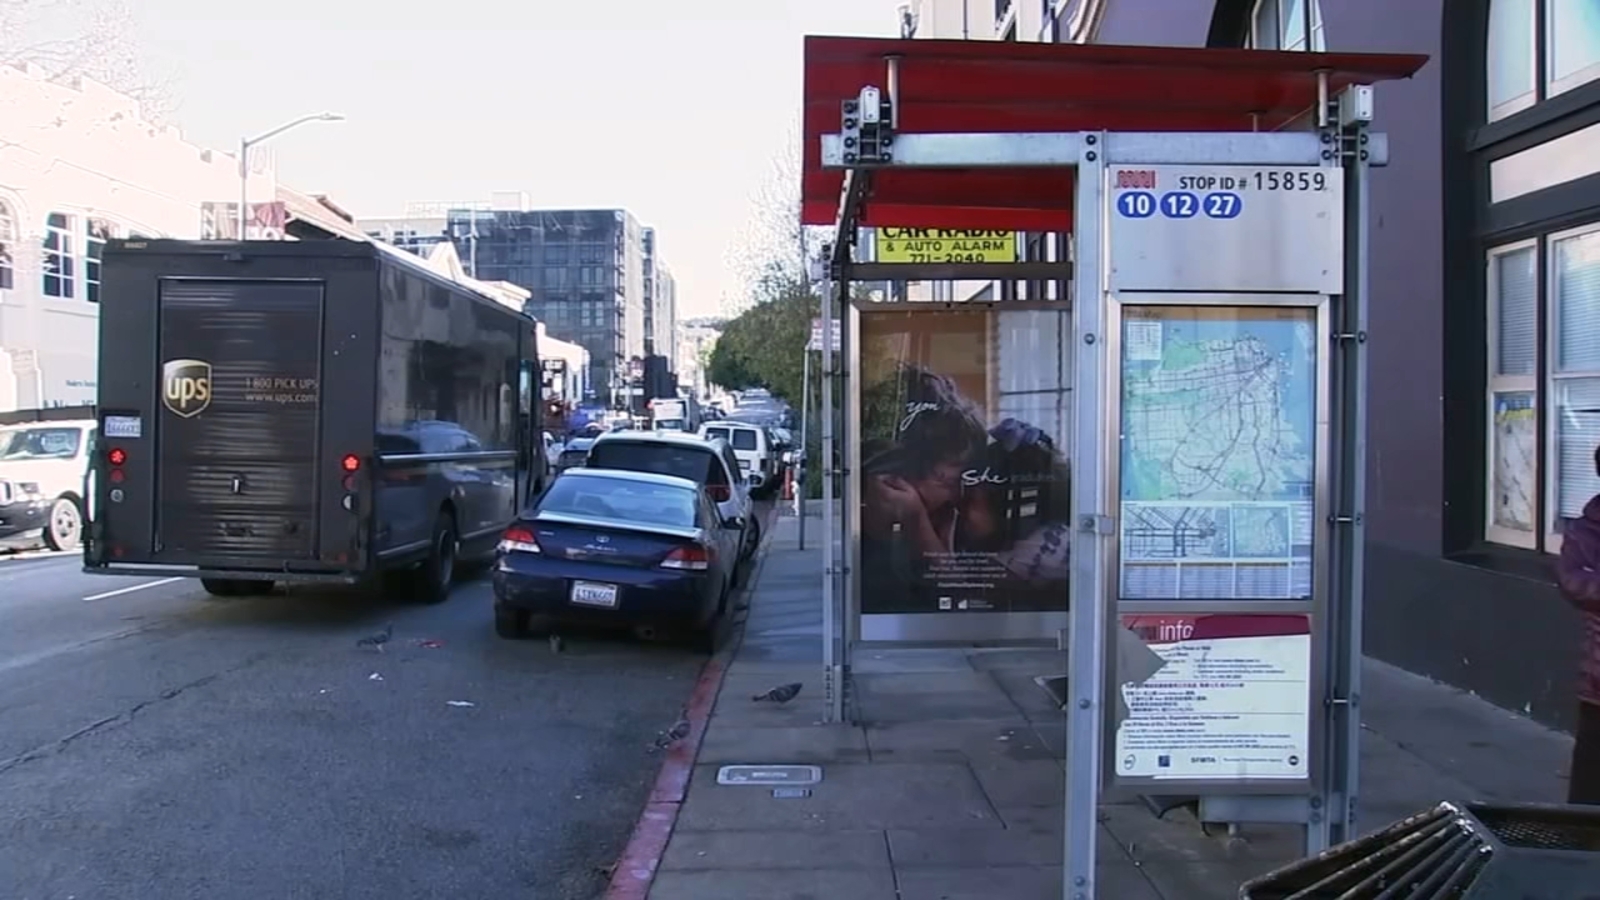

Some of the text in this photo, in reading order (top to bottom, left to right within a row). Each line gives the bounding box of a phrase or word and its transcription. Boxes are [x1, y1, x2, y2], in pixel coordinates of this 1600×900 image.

[1179, 171, 1325, 191] STOP ID # 15859
[1124, 195, 1235, 215] 10 12 27
[886, 241, 1005, 252] & AUTO ALARM
[909, 253, 985, 263] 771-2040
[166, 377, 208, 409] ups
[253, 379, 272, 389] 800
[275, 379, 296, 389] PICK
[299, 379, 318, 389] UPS
[245, 393, 317, 404] www.ups.com
[961, 467, 1007, 486] She
[1160, 620, 1194, 640] info
